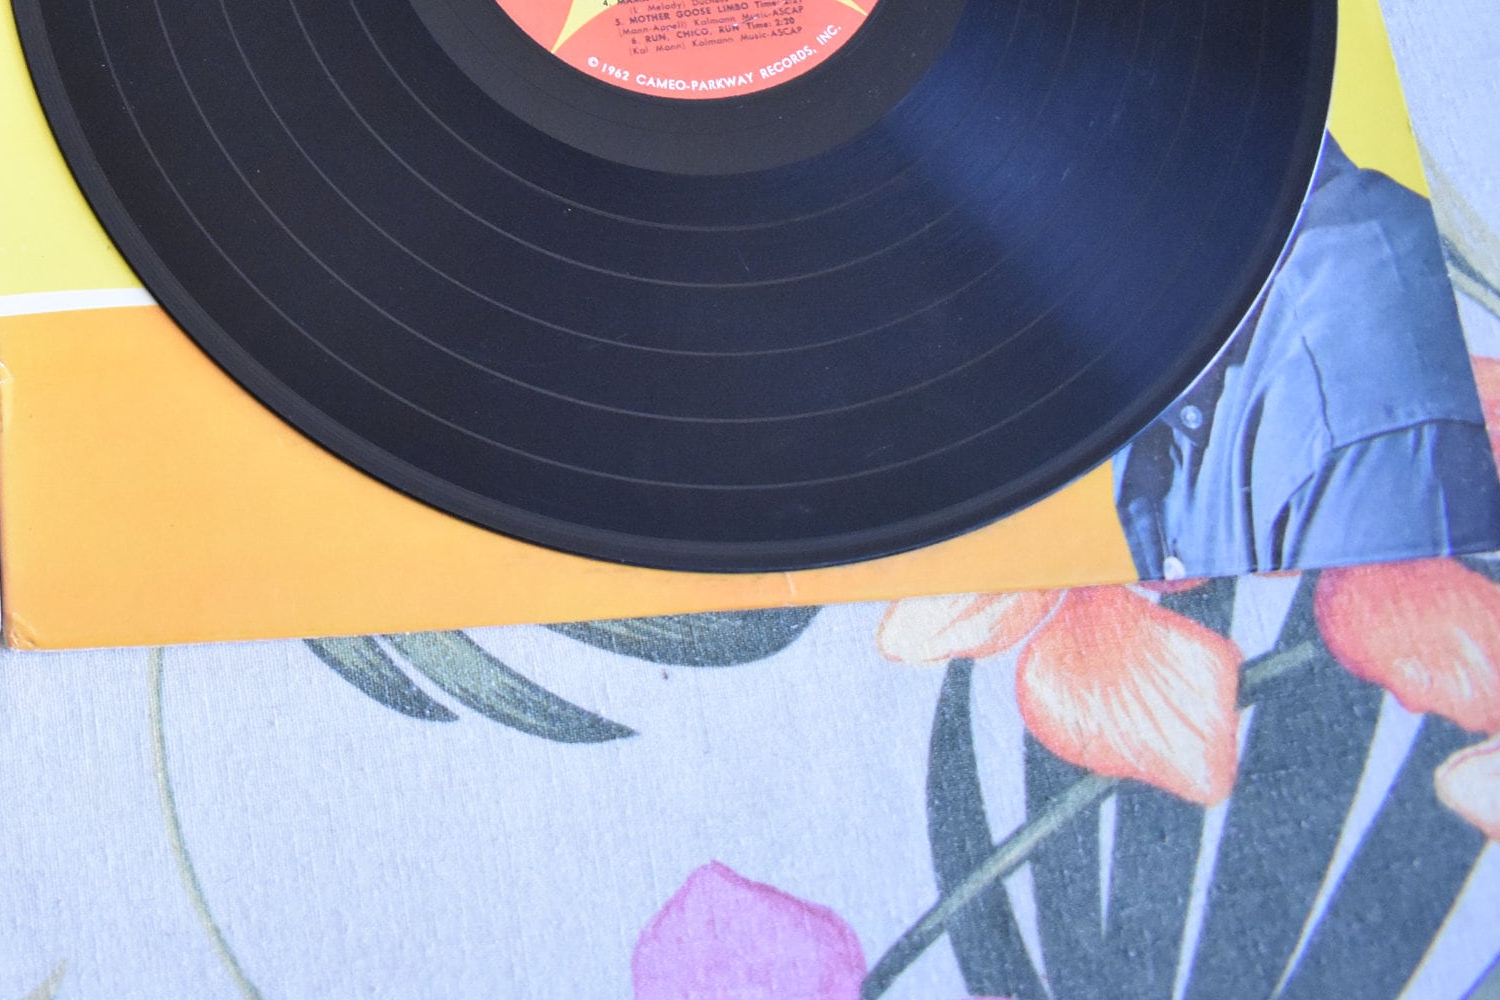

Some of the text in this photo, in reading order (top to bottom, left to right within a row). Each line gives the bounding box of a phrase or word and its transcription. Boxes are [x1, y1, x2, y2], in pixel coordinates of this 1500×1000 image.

[629, 12, 670, 24] MOTHER
[675, 7, 711, 18] GOOSE
[717, 2, 748, 13] LIMBO
[601, 24, 841, 90] 1962 CAMEO-PARKWAY RECORDS, INC.
